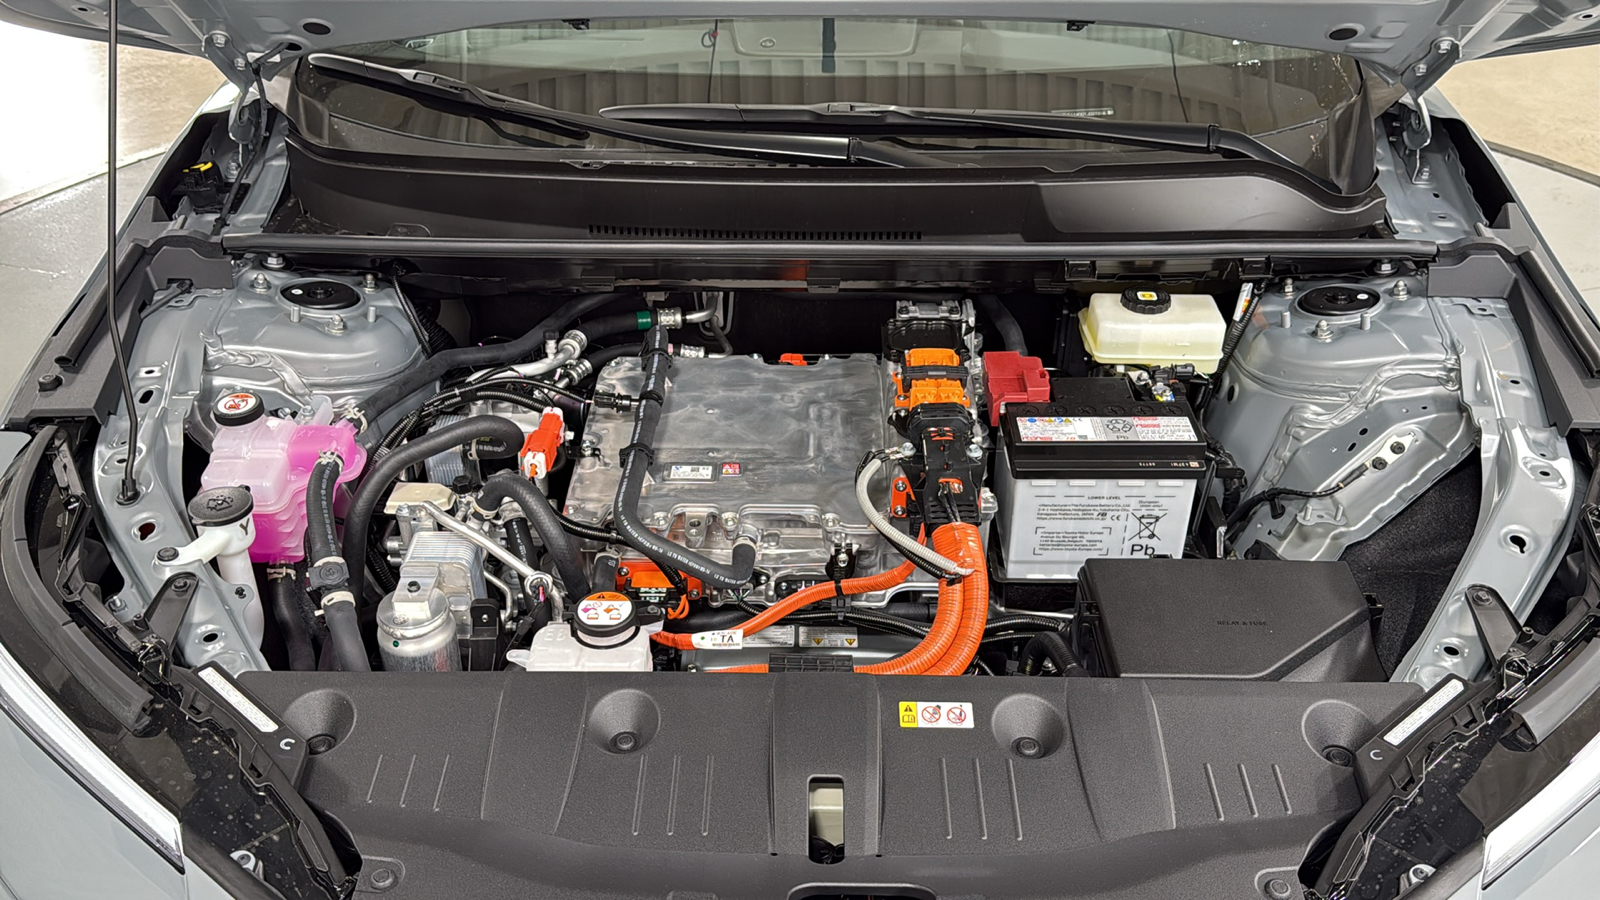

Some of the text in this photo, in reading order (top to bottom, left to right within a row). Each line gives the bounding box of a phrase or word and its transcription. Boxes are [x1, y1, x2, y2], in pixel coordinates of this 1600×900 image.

[239, 518, 250, 536] Y
[1130, 544, 1155, 556] Pb
[720, 634, 734, 643] TA
